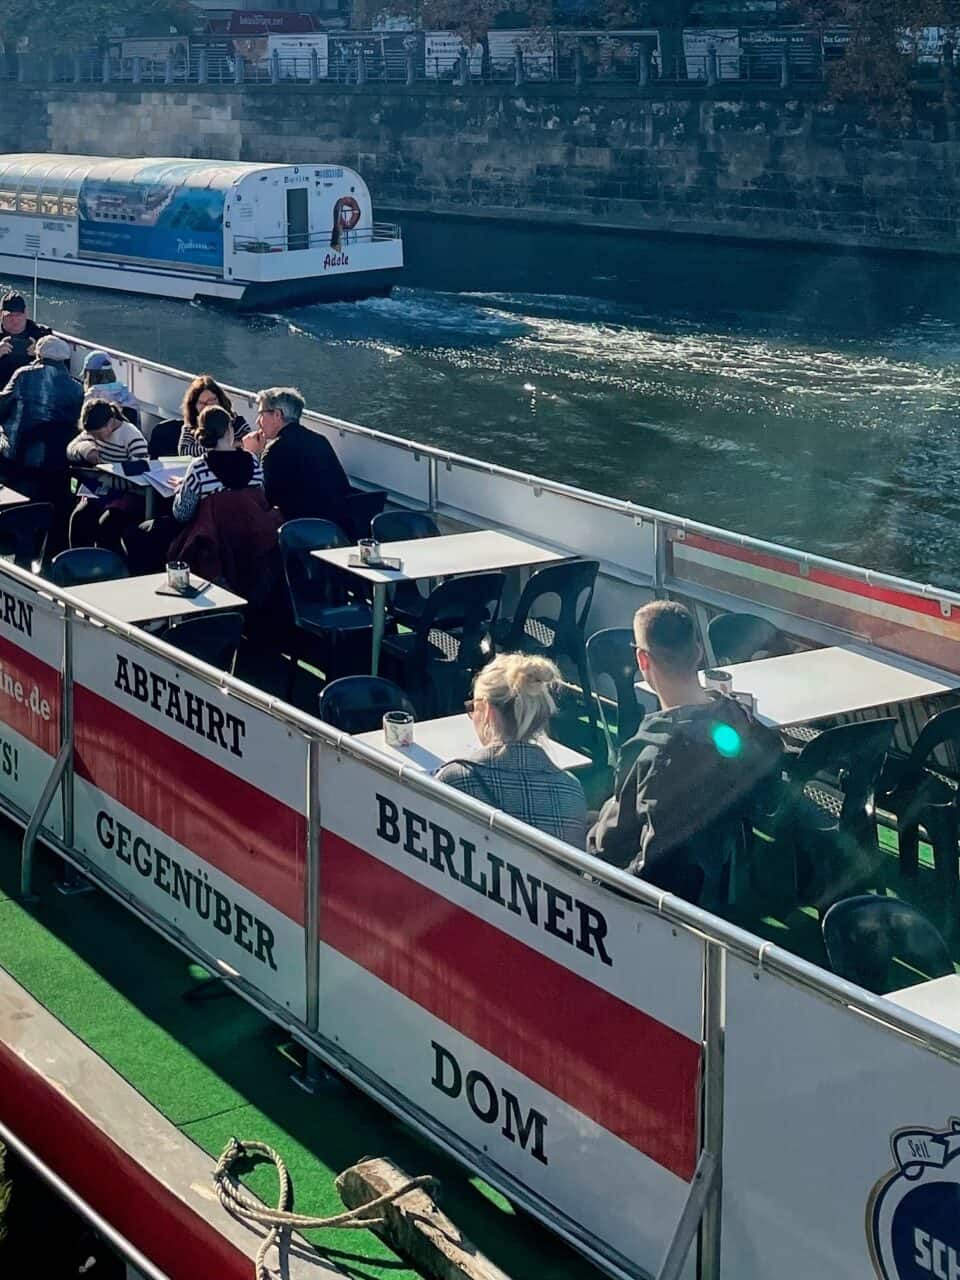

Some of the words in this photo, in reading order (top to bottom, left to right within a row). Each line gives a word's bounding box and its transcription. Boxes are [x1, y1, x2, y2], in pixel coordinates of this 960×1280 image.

[114, 653, 246, 758] ABFAHRT
[96, 810, 279, 972] GEGENÜBER
[375, 792, 613, 968] BERLINER
[431, 1039, 548, 1166] DOM
